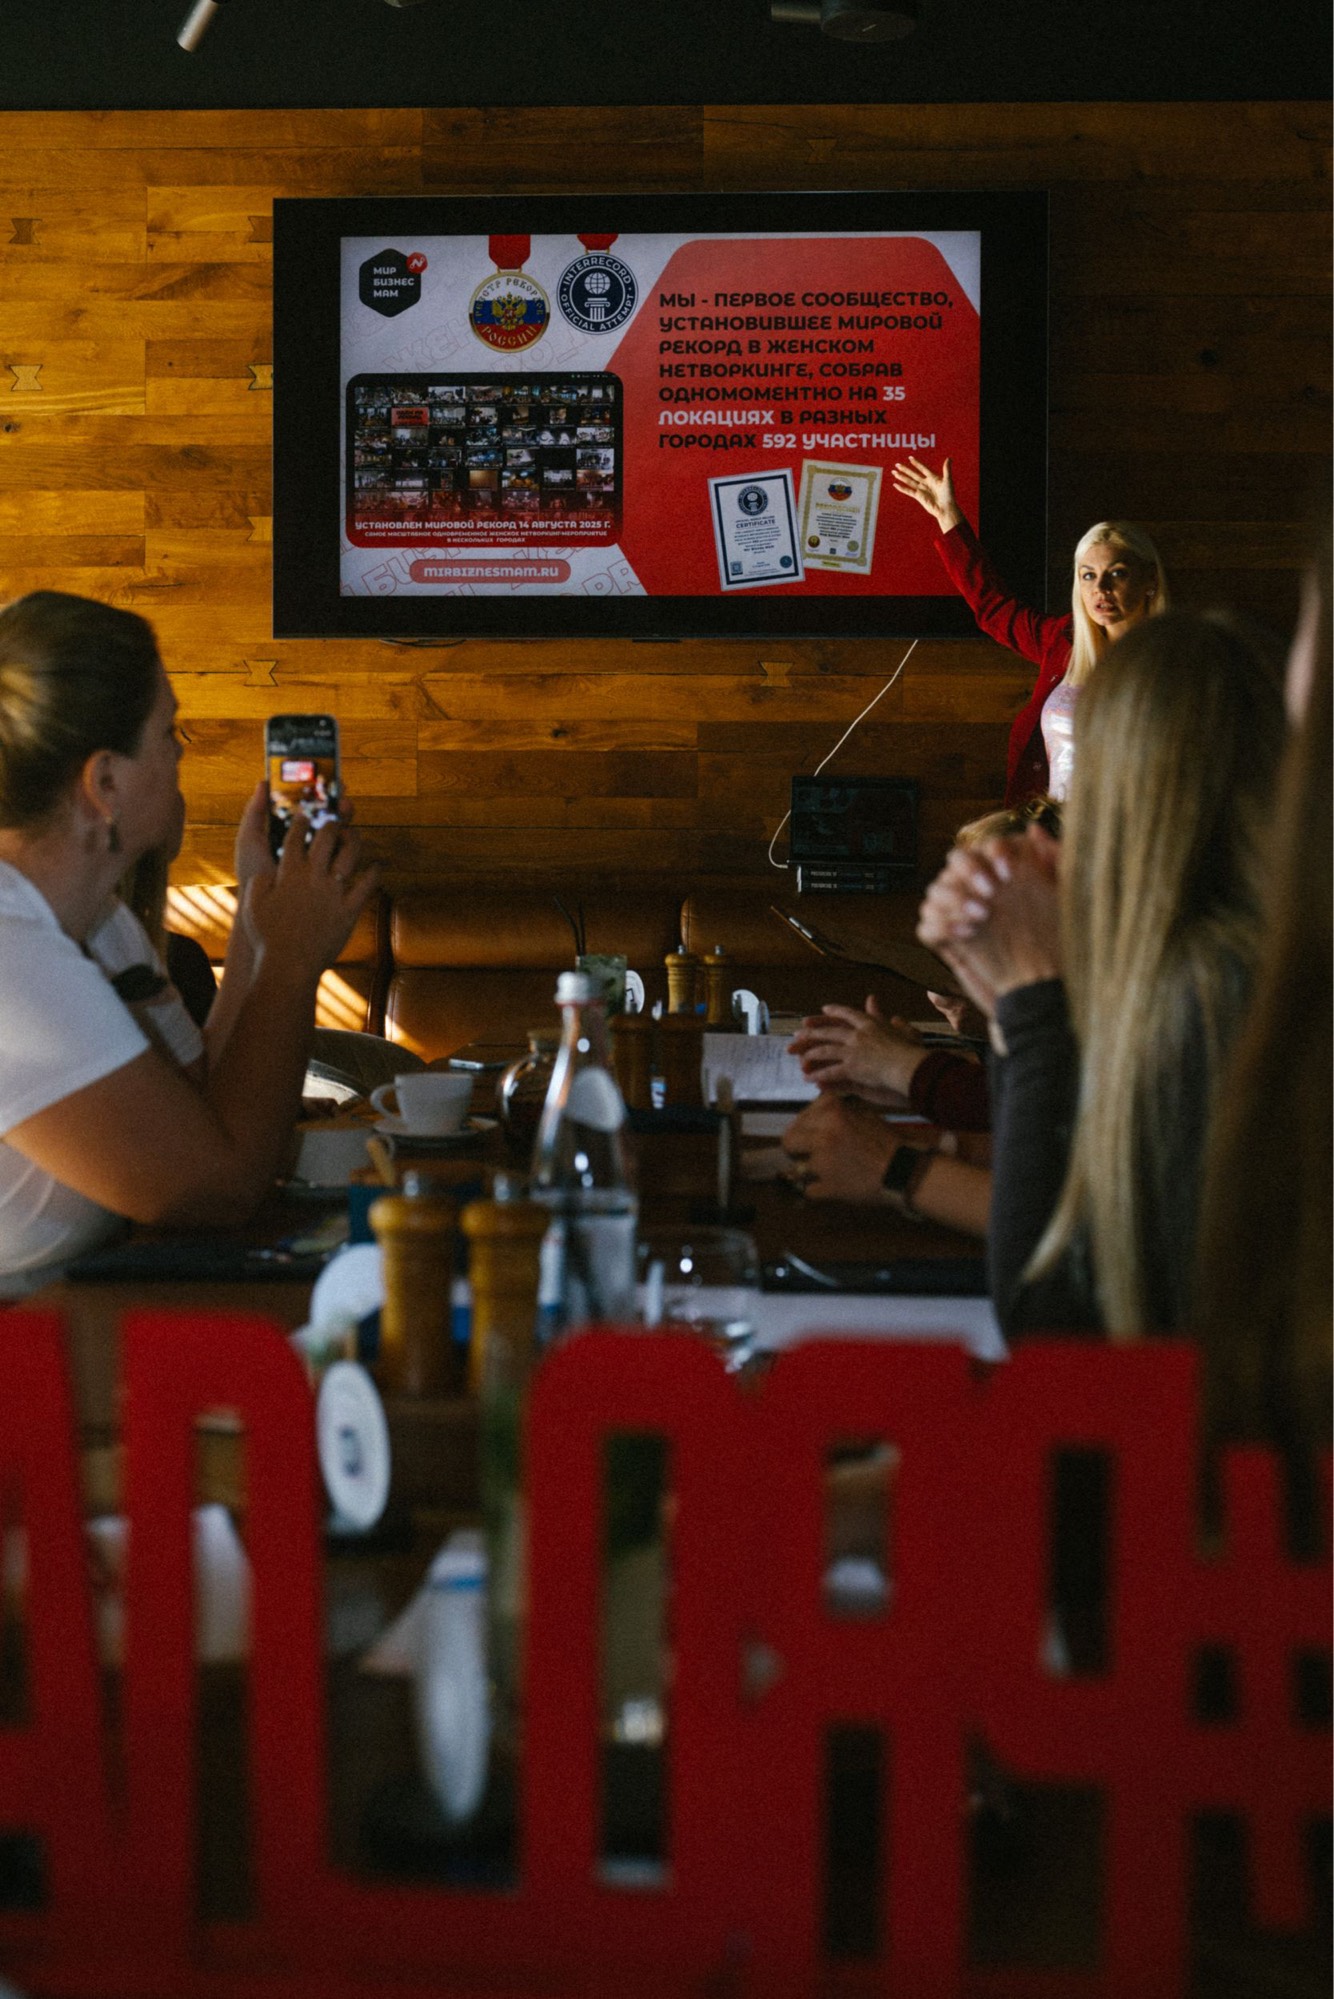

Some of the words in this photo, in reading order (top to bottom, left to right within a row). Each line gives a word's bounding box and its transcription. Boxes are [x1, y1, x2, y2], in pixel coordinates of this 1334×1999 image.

[373, 266, 397, 275] МИР
[563, 257, 631, 285] INTERRECORD
[373, 278, 415, 286] БИЗНЕС
[373, 289, 399, 298] МАМ
[659, 293, 695, 308] МЫ
[714, 292, 796, 307] ПЕРВОЕ
[801, 291, 954, 309] СООБЩЕСТВО,
[561, 294, 595, 330] OFFICIAL
[600, 294, 634, 330] ATTEMPT
[659, 316, 832, 332] УСТАНОВИВШЕЕ
[838, 312, 943, 330] МИРОВОЙ
[481, 324, 537, 346] РОССИИ
[659, 339, 743, 357] РЕКОРД
[748, 339, 762, 354] В
[767, 339, 874, 354] ЖЕНСКОМ
[659, 363, 814, 379] НЕТВОРКИНГЕ,
[819, 363, 903, 377] СОБРАВ
[658, 386, 843, 403] ОДНОМОМЕНТНО
[849, 387, 877, 401] НА
[883, 386, 906, 401] 35
[658, 410, 774, 427] ЛОКАЦИЯХ
[780, 410, 793, 424] В
[799, 410, 887, 425] РАЗНЫХ
[659, 434, 756, 450] ГОРОДАХ
[762, 433, 796, 448] 592
[802, 433, 936, 450] УЧАСТНИЦЫ
[355, 521, 422, 530] УСТАНОВЛЕН
[425, 520, 475, 529] МИРОВОЙ
[476, 521, 517, 529] РЕКОРД
[519, 521, 530, 529] 14
[532, 521, 577, 529] АВГУСТА
[579, 521, 602, 529] 2025
[736, 519, 775, 529] CERTIFICATE
